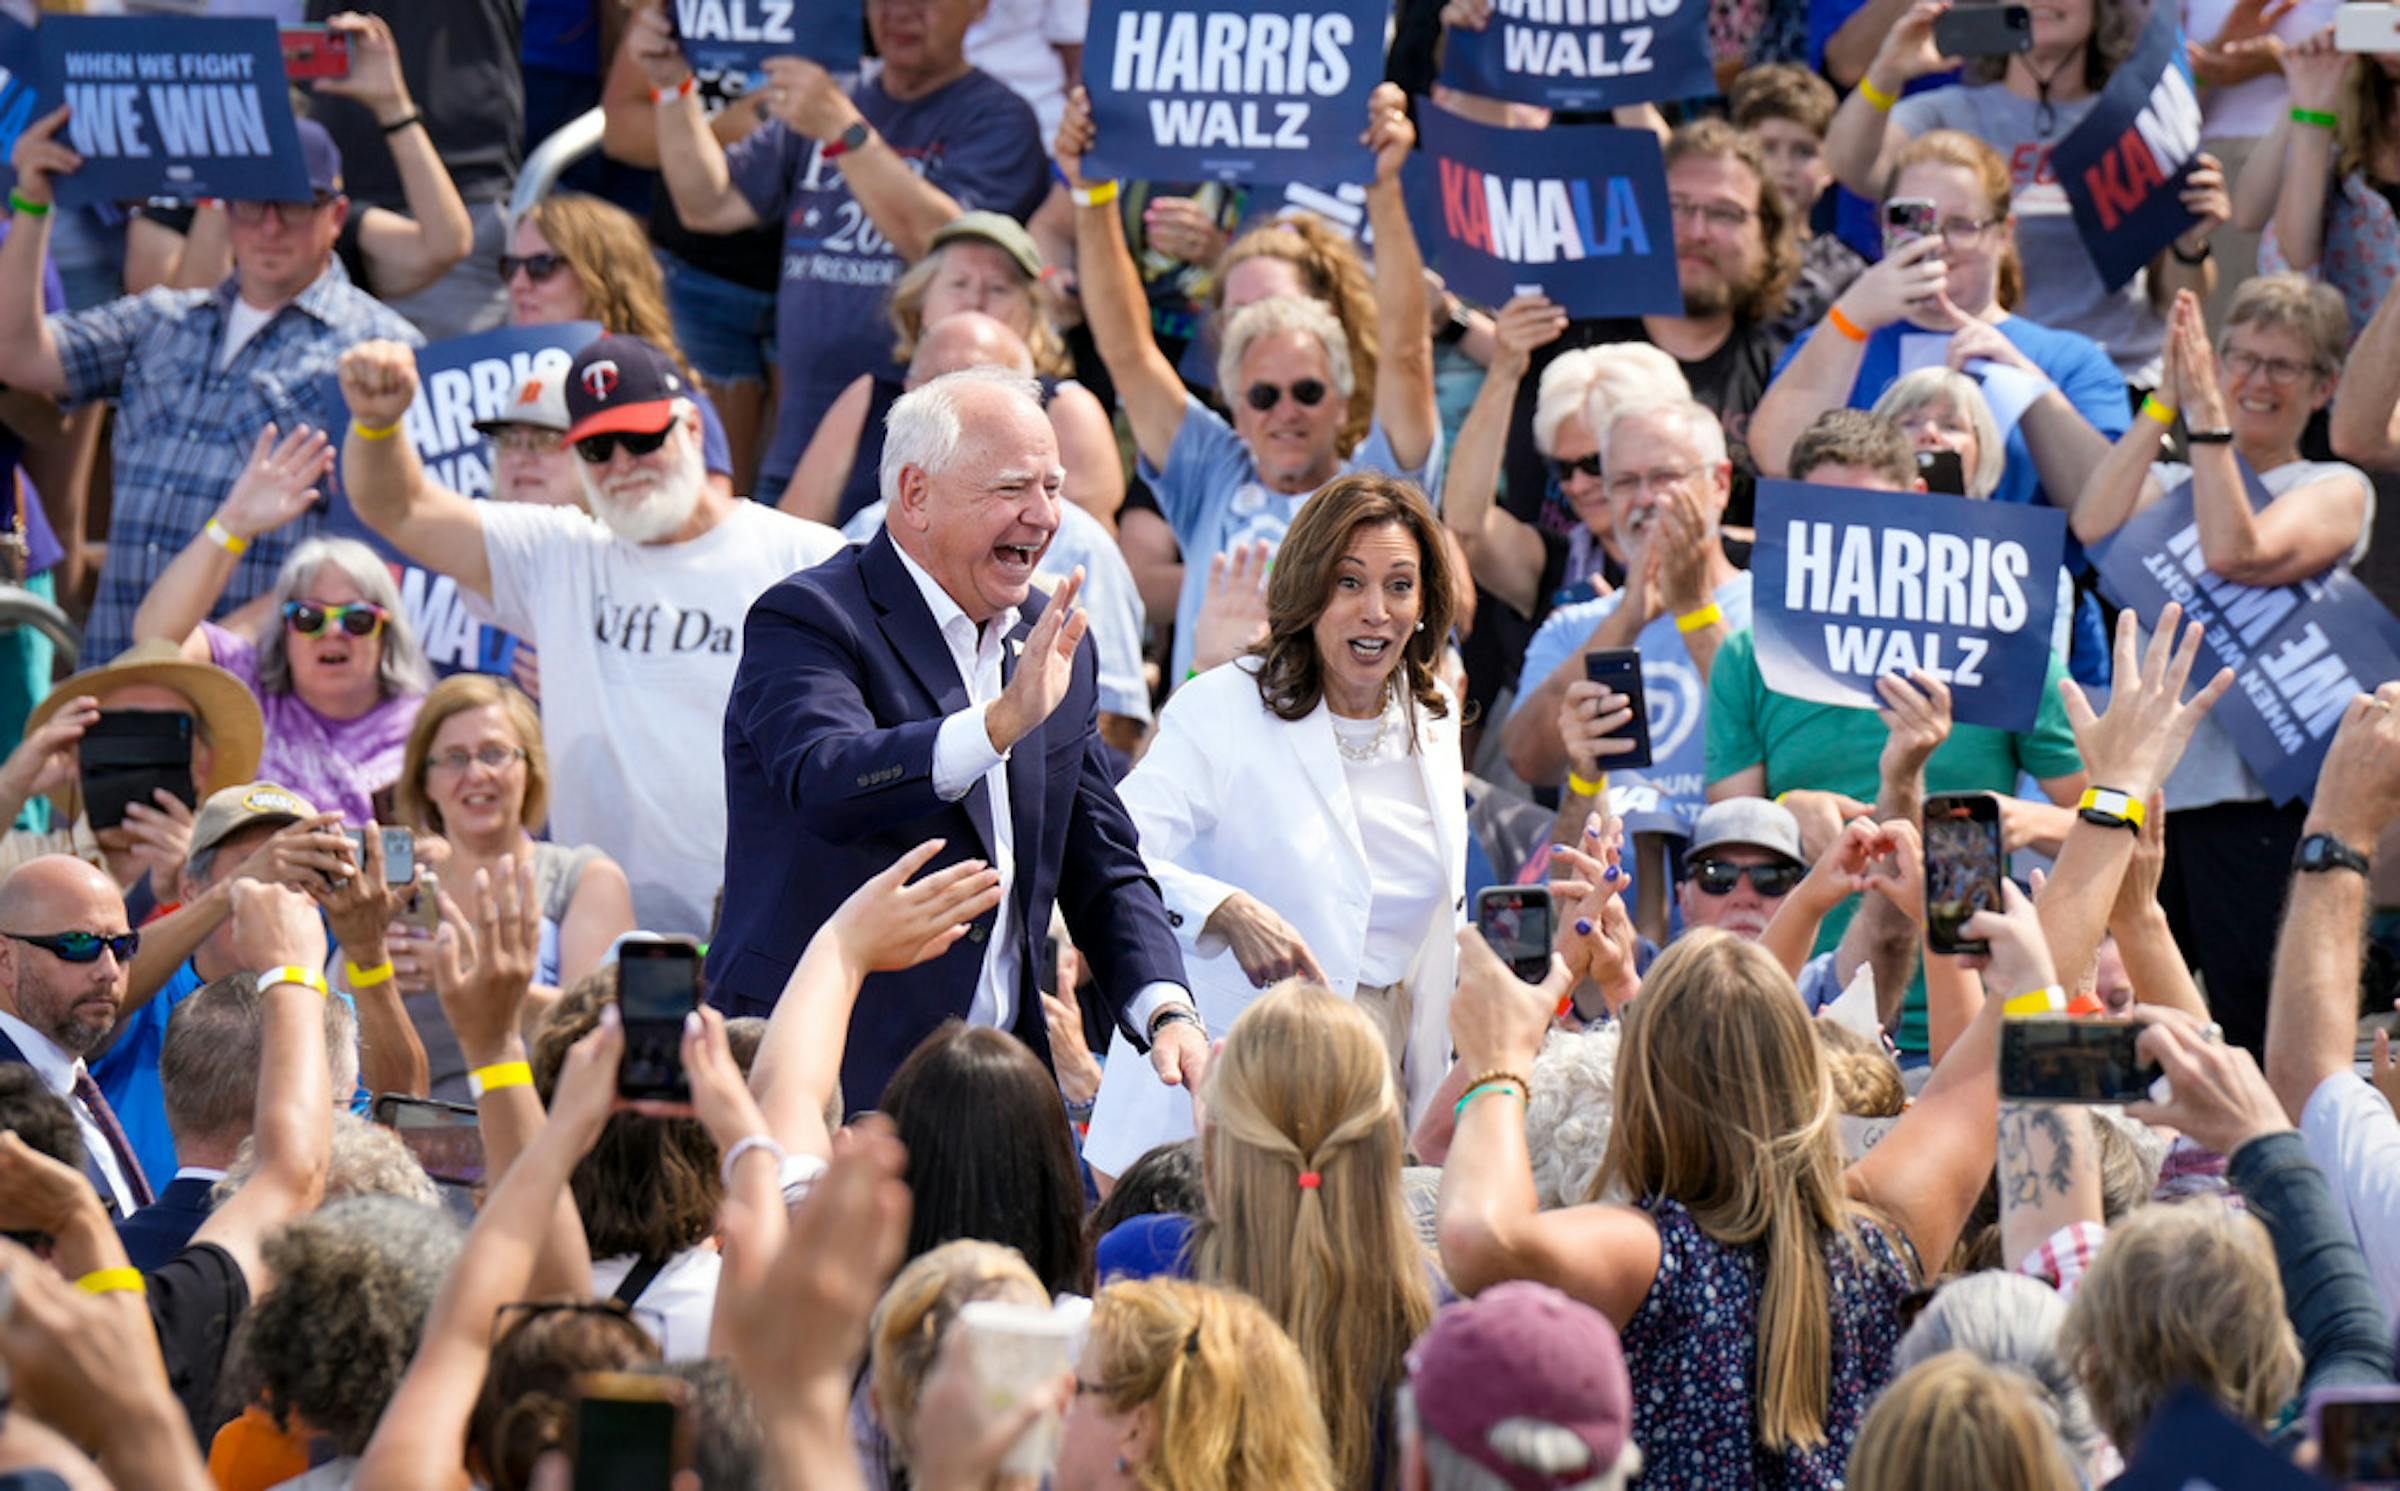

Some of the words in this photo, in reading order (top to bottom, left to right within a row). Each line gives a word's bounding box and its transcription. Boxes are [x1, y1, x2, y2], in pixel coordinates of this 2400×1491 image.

[65, 51, 133, 78] WHEN
[136, 53, 176, 78] WE
[180, 53, 253, 78] FIGHT
[1111, 11, 1354, 96] HARRIS
[1504, 25, 1654, 77] WALZ
[64, 82, 151, 157] WE
[148, 84, 272, 156] WIN
[1149, 99, 1310, 149] WALZ
[1438, 157, 1651, 263] KAMALA
[1785, 519, 2029, 633] HARRIS
[2141, 552, 2215, 625] FIGHT
[595, 595, 660, 653] Uff
[672, 607, 734, 654] Da
[1824, 622, 1989, 687] WALZ
[2204, 624, 2247, 671] WE
[2237, 668, 2306, 756] WHEN
[2258, 620, 2365, 741] WE
